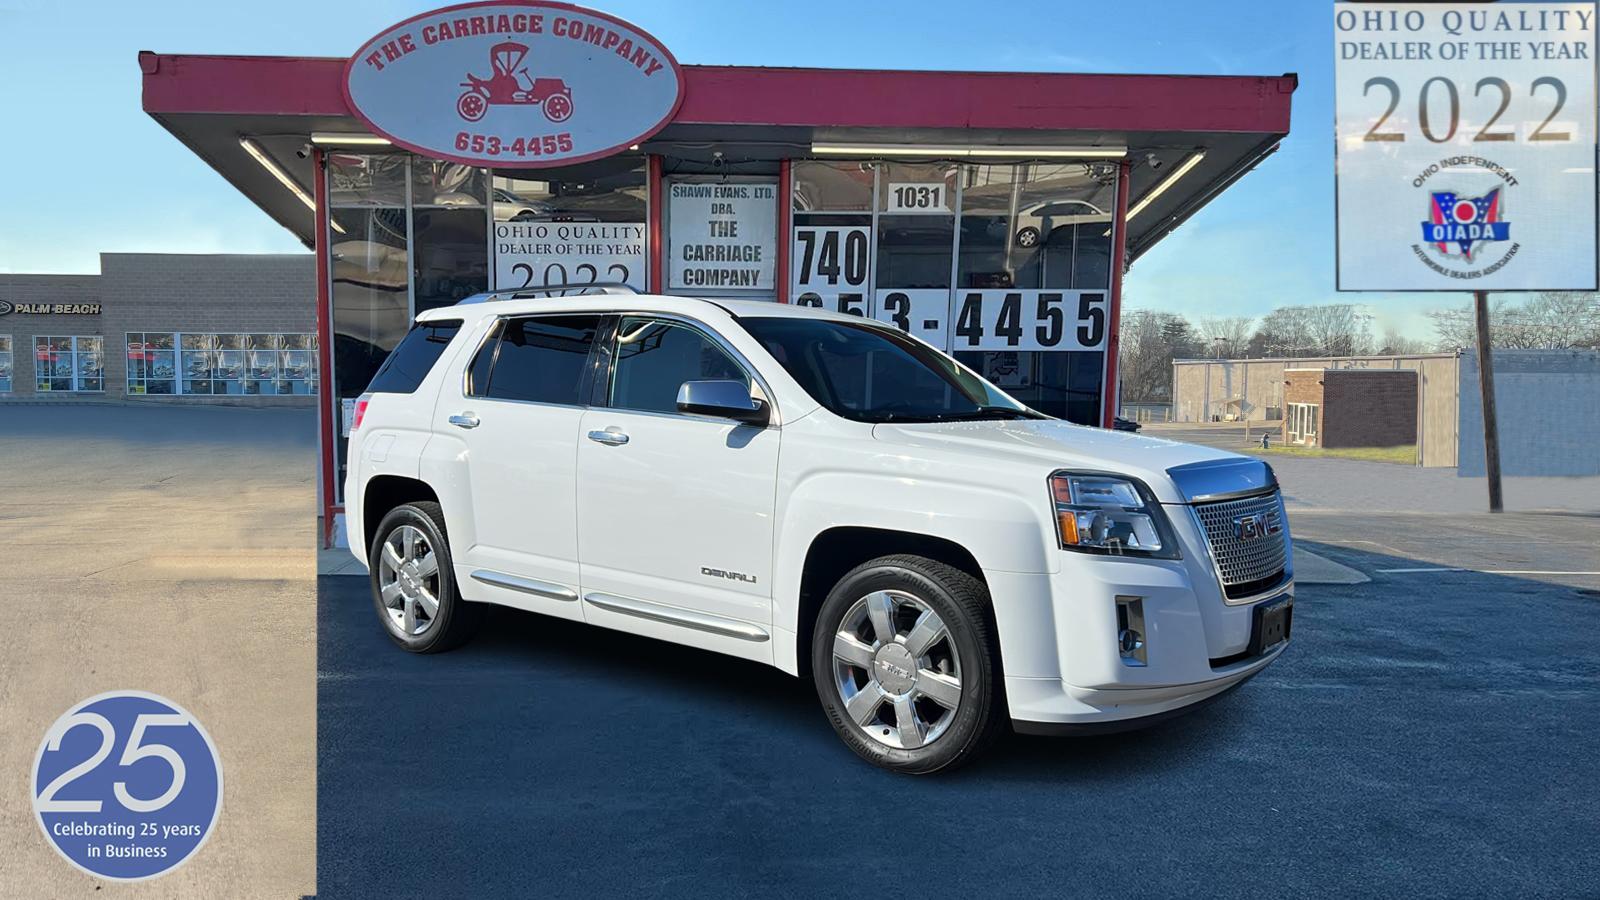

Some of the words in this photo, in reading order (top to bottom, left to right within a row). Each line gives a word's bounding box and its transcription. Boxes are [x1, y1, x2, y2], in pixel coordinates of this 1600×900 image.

[1336, 10, 1425, 31] OHIO
[1442, 9, 1592, 36] QUALITY
[365, 33, 417, 72] THE
[421, 14, 544, 45] CARRIAGE
[553, 17, 664, 77] COMPANY
[1340, 41, 1433, 60] DEALER
[1439, 41, 1470, 60] OF
[1474, 42, 1521, 60] THE
[1527, 42, 1589, 60] YEAR
[1362, 76, 1571, 143] 2022
[455, 132, 573, 156] 653-4455
[1412, 164, 1440, 188] OHIO
[1440, 155, 1519, 187] INDEPENDENT
[672, 186, 712, 199] SHAWN
[754, 187, 775, 200] LTD.
[894, 186, 940, 208] 1031
[711, 203, 736, 215] DBA.
[497, 226, 548, 239] OHIO
[557, 226, 644, 241] QUALITY
[708, 220, 738, 238] THE
[1432, 225, 1495, 241] OIADA
[500, 243, 552, 255] DEALER
[556, 243, 574, 255] OF
[576, 243, 603, 255] THE
[606, 244, 641, 255] YEAR
[683, 245, 762, 262] CARRIAGE
[797, 230, 868, 286] 740
[683, 269, 760, 286] COMPANY
[14, 303, 51, 314] PALM
[54, 303, 101, 315] BEACH
[1239, 512, 1279, 539] GMC
[700, 567, 757, 584] DENALI
